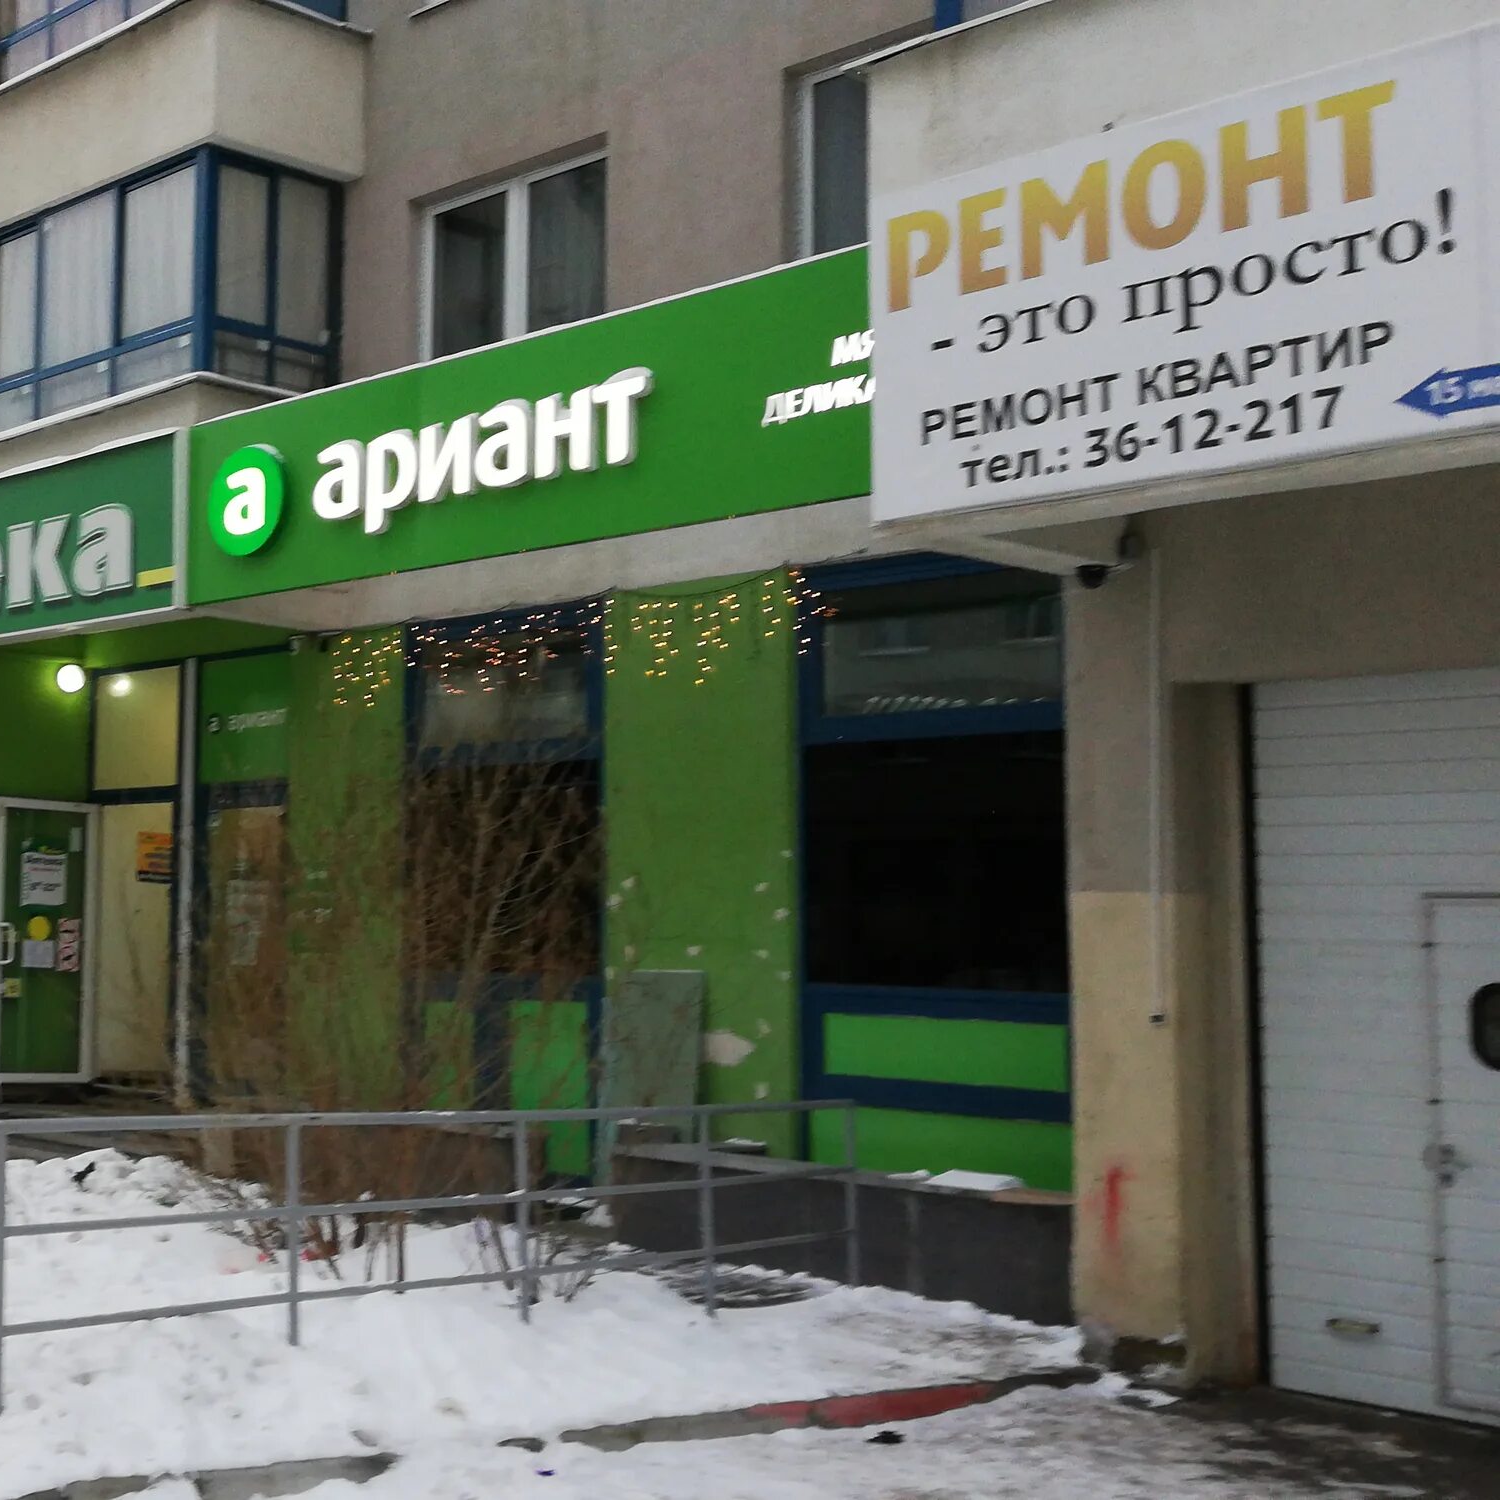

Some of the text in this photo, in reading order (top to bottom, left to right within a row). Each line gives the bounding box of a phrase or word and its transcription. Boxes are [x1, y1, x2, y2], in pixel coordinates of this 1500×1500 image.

[887, 80, 1396, 313] РЕМОНТ
[977, 294, 1097, 354] это
[1121, 186, 1458, 334] просто!
[312, 366, 655, 535] ариант
[919, 320, 1396, 446] РЕМОНТ КВАРТИР
[958, 386, 1347, 489] тел.: 36-12-217
[1424, 376, 1463, 406] 15
